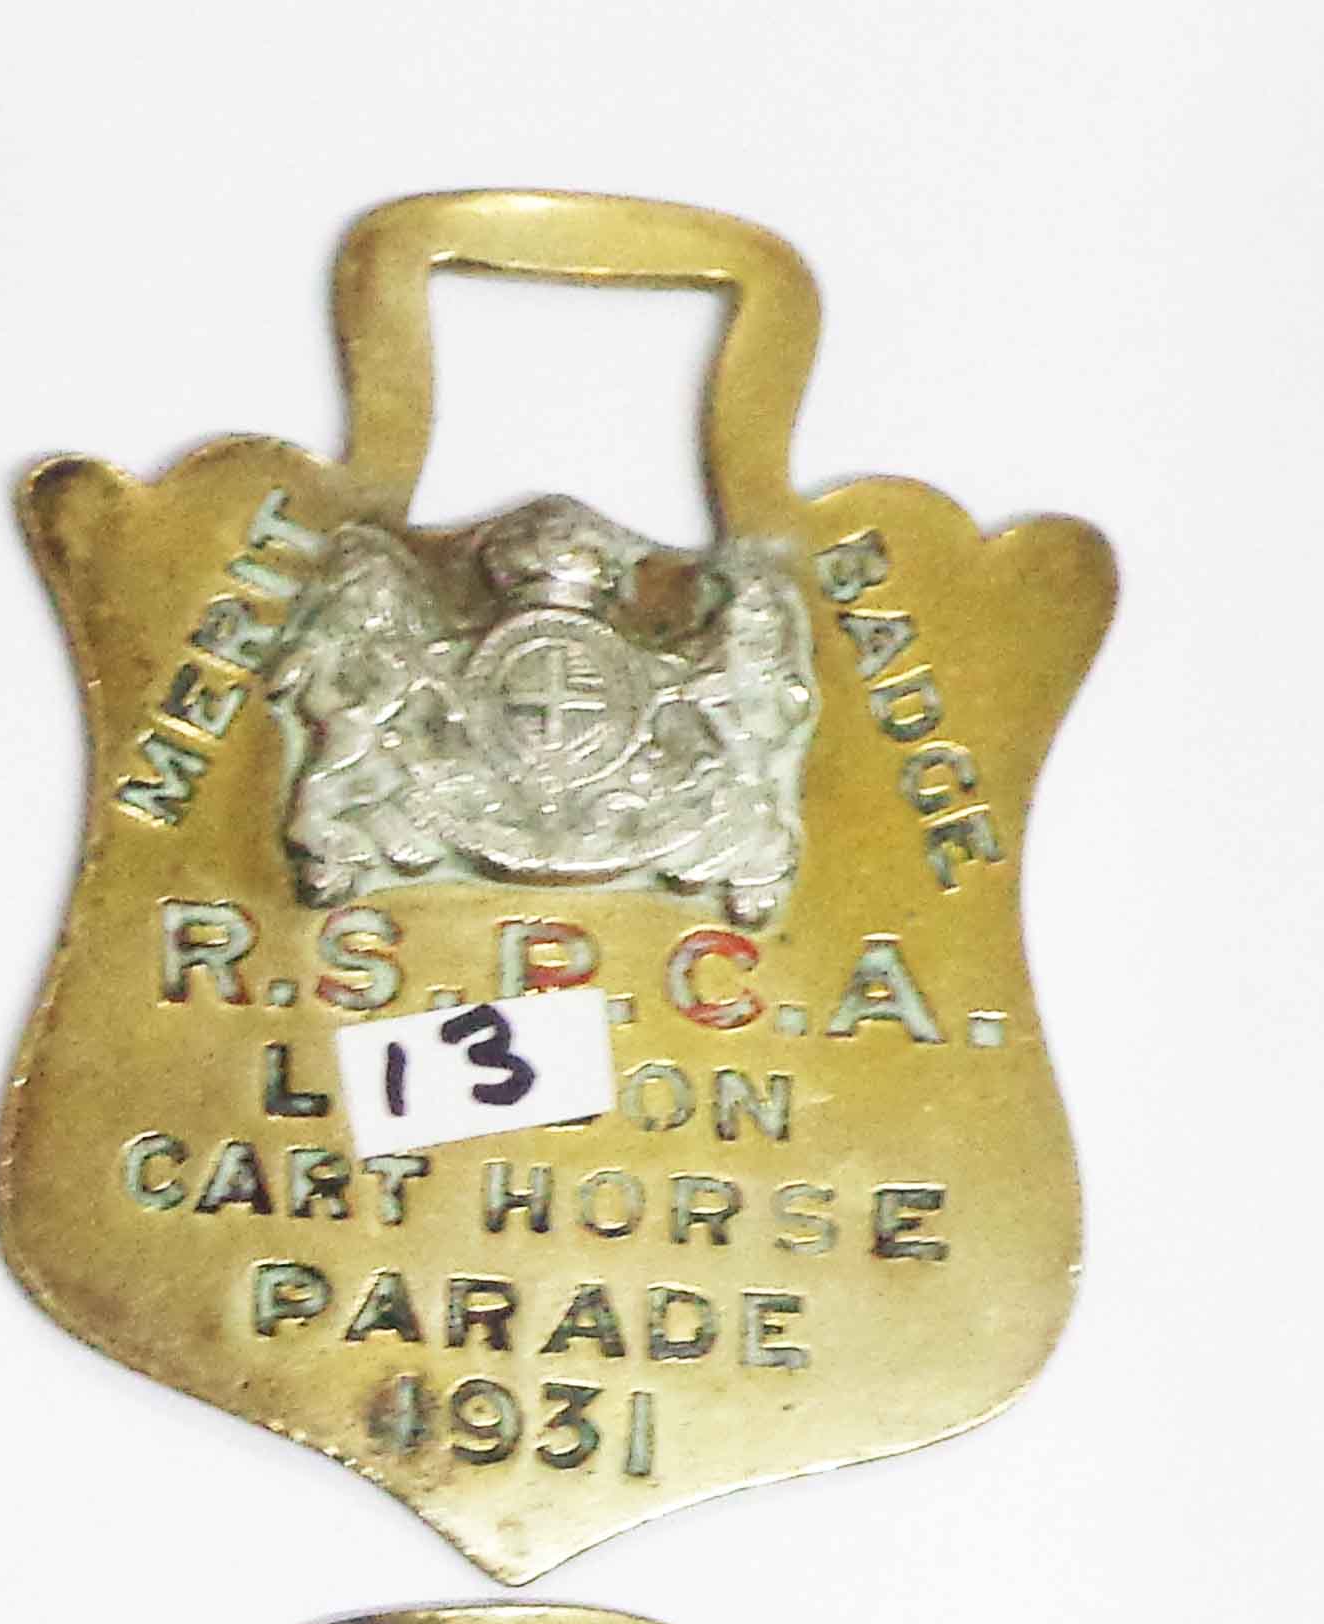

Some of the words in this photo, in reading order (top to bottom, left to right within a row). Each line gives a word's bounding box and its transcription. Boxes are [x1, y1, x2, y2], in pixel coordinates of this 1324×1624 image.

[116, 487, 325, 828] MERIT
[814, 528, 1004, 893] BADGE
[383, 1003, 538, 1115] 13
[123, 1130, 430, 1226] CART
[482, 1160, 950, 1262] HORSE
[250, 1257, 810, 1370] PARADE
[365, 1371, 661, 1476] 1931
